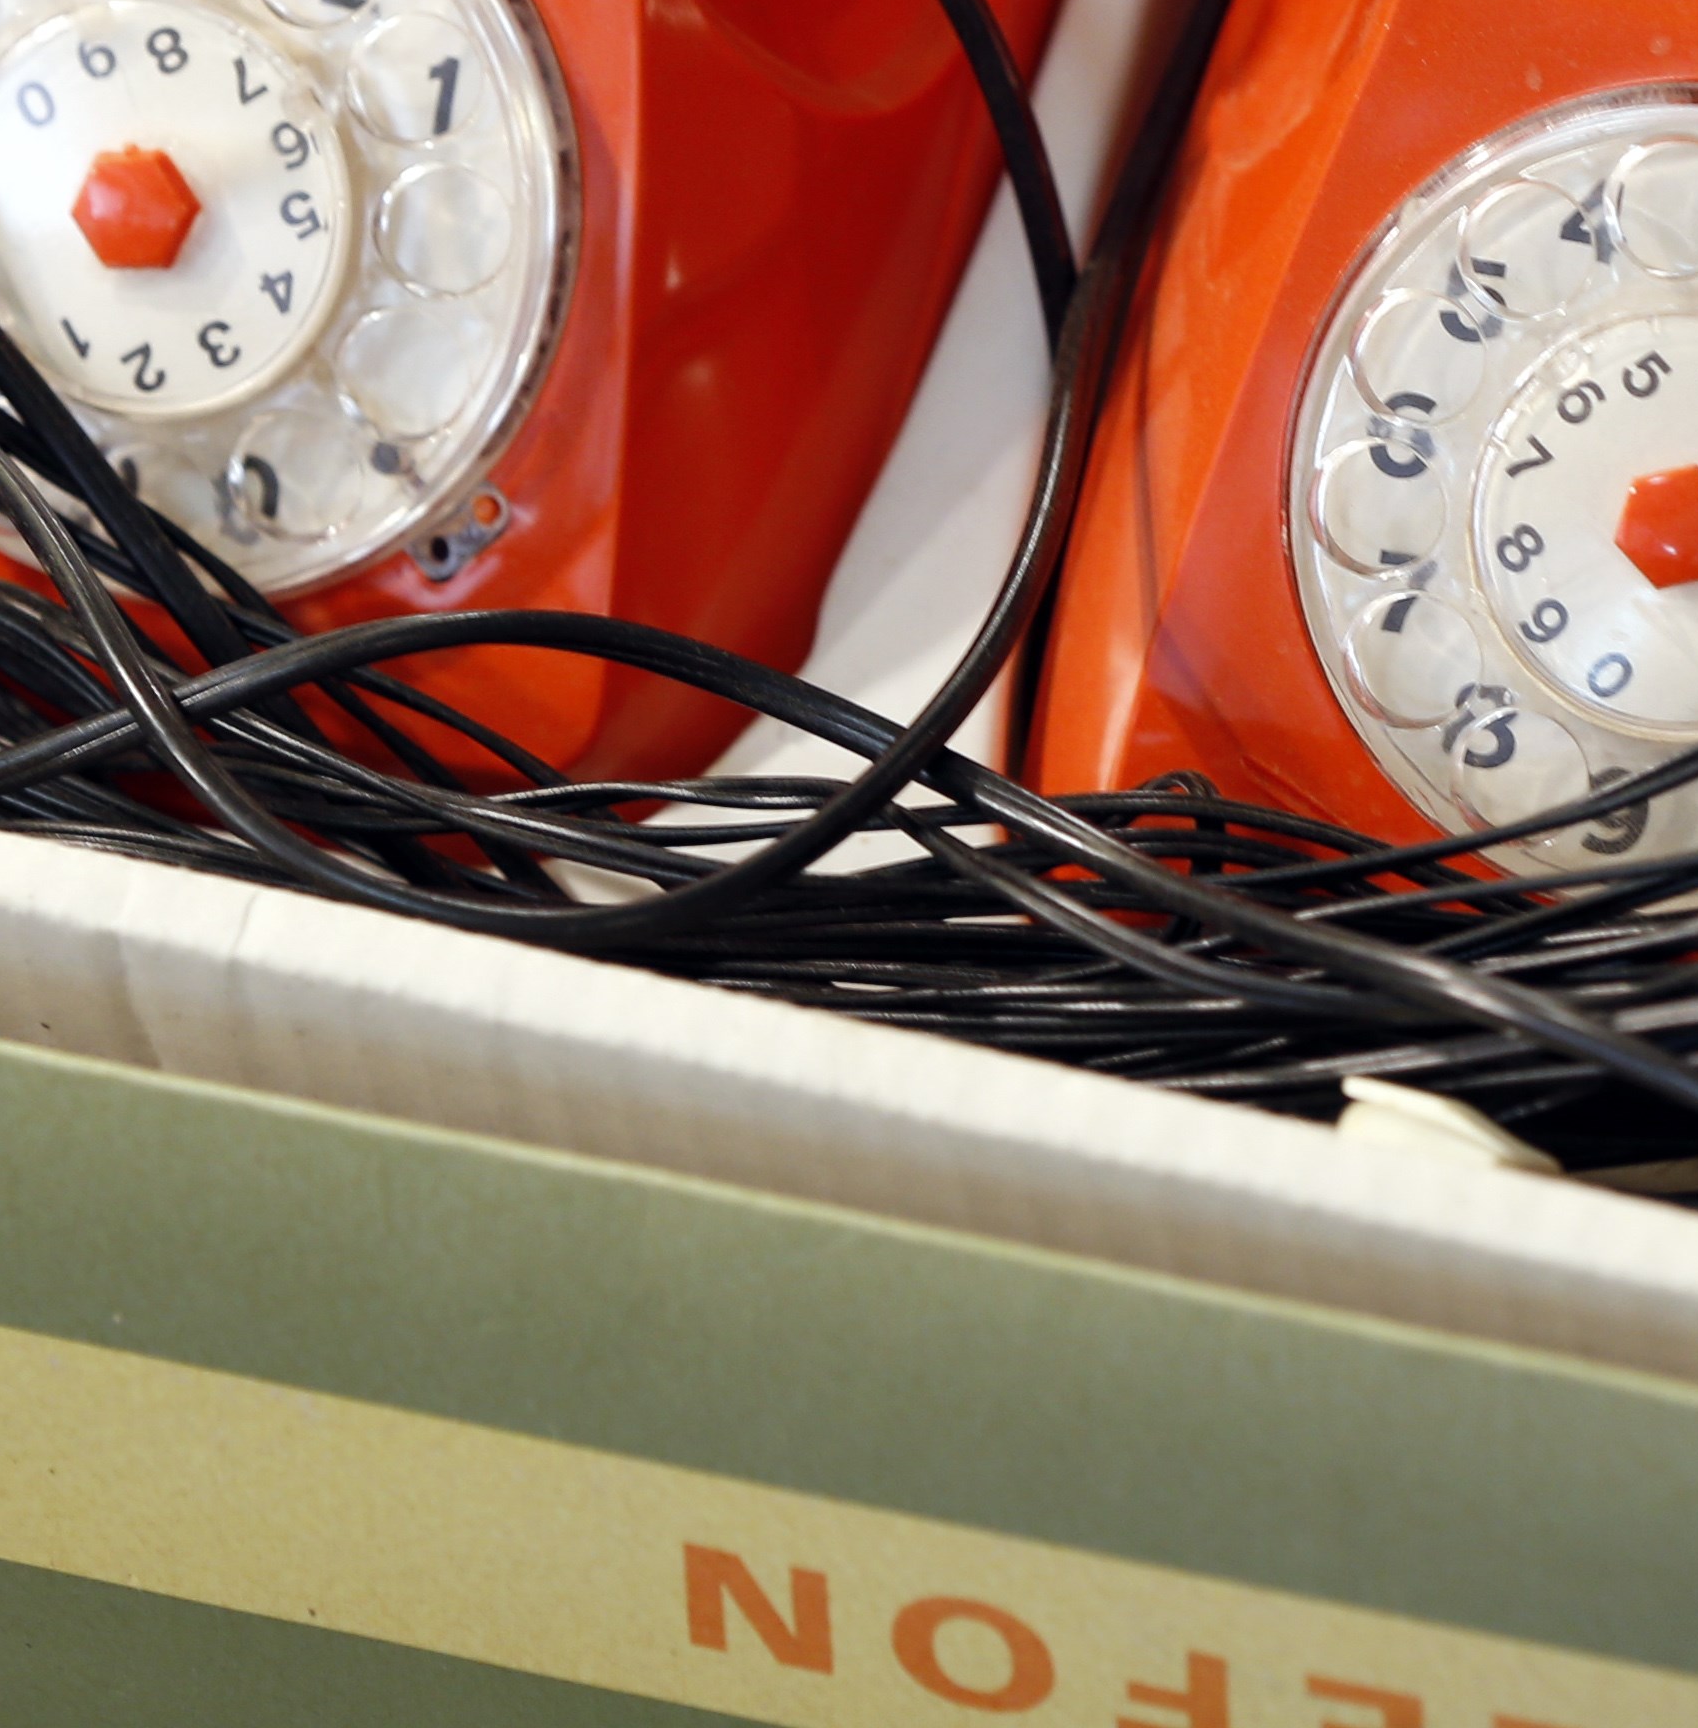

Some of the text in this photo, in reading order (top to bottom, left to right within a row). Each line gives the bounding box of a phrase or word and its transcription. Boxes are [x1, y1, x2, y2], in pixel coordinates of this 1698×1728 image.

[145, 28, 190, 75] 8
[17, 81, 56, 128] 0
[232, 56, 269, 105] 7
[426, 56, 460, 138] 1
[271, 121, 309, 170] 6
[279, 190, 322, 241] 5
[1560, 177, 1626, 264] 4
[259, 270, 296, 314] 4
[61, 318, 91, 360] 1
[197, 320, 241, 368] 3
[120, 343, 166, 393] 2
[1621, 350, 1672, 398] 5
[1556, 378, 1605, 425] 6
[1505, 435, 1555, 479] 7
[1494, 522, 1546, 574] 8
[1519, 598, 1570, 644] 9
[1587, 651, 1635, 698] 0
